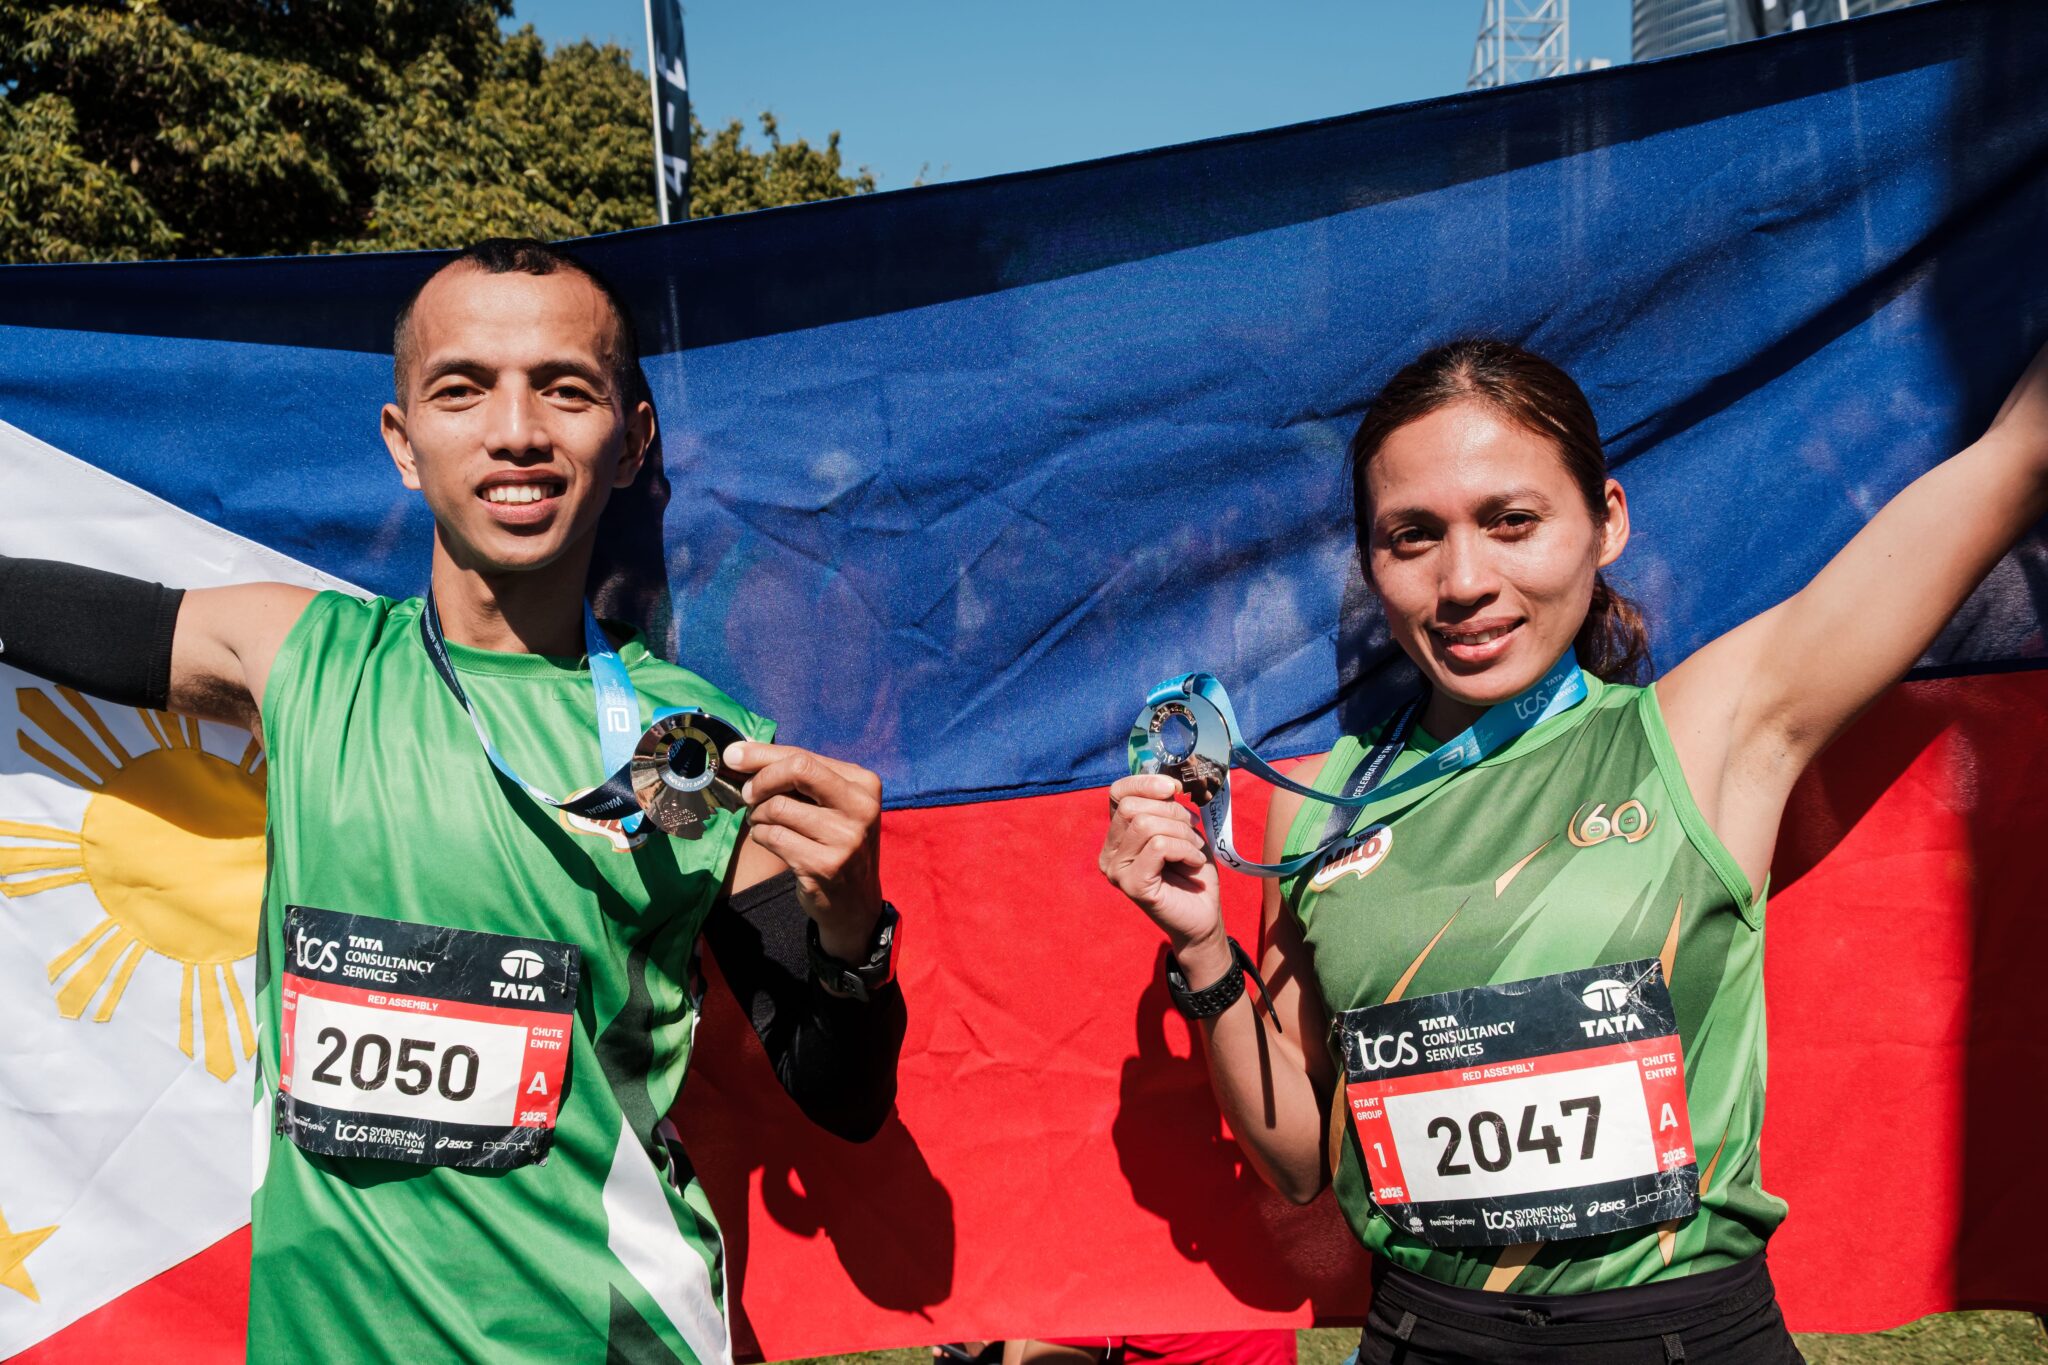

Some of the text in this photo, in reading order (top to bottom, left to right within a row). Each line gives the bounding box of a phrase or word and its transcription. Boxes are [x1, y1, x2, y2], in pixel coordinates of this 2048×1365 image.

[1545, 673, 1564, 687] TATA
[1514, 690, 1549, 719] tcs
[1353, 752, 1387, 797] CELEBRATING
[1580, 799, 1648, 842] 60
[1320, 837, 1382, 876] MILO
[296, 927, 340, 973] tcs
[348, 936, 384, 951] TATA
[345, 950, 435, 973] CONSULTANCY
[342, 965, 398, 983] SERVICES
[490, 981, 546, 1002] TATA
[367, 994, 439, 1012] RED ASSEMBLY
[532, 1027, 563, 1038] CHUTE
[1419, 1015, 1459, 1032] TATA
[1580, 1013, 1645, 1038] TATA
[1422, 1021, 1516, 1047] CONSULTANCY
[530, 1039, 562, 1050] ENTRY
[1357, 1030, 1419, 1071] tcs
[1425, 1042, 1484, 1063] SERVICES
[312, 1026, 480, 1101] 2050
[1642, 1053, 1676, 1067] CHUTE
[1462, 1062, 1535, 1082] RED ASSEMBLY
[1644, 1066, 1678, 1080] ENTRY
[526, 1071, 548, 1096] A
[1354, 1097, 1379, 1109] START
[520, 1111, 548, 1122] 2025
[1357, 1109, 1383, 1121] GROUP
[1659, 1102, 1679, 1132] A
[335, 1119, 368, 1142] tcs
[370, 1126, 407, 1139] SYDNEY
[1427, 1095, 1602, 1177] 2047
[368, 1136, 425, 1149] MARATHON
[447, 1139, 474, 1150] asics
[1373, 1142, 1387, 1169] 1
[1662, 1146, 1687, 1165] 2025
[1379, 1186, 1404, 1199] 2025
[1515, 1206, 1552, 1220] SYDNEY
[1599, 1199, 1626, 1213] asics
[1482, 1208, 1516, 1230] tcs
[1516, 1212, 1577, 1228] MARATHON
